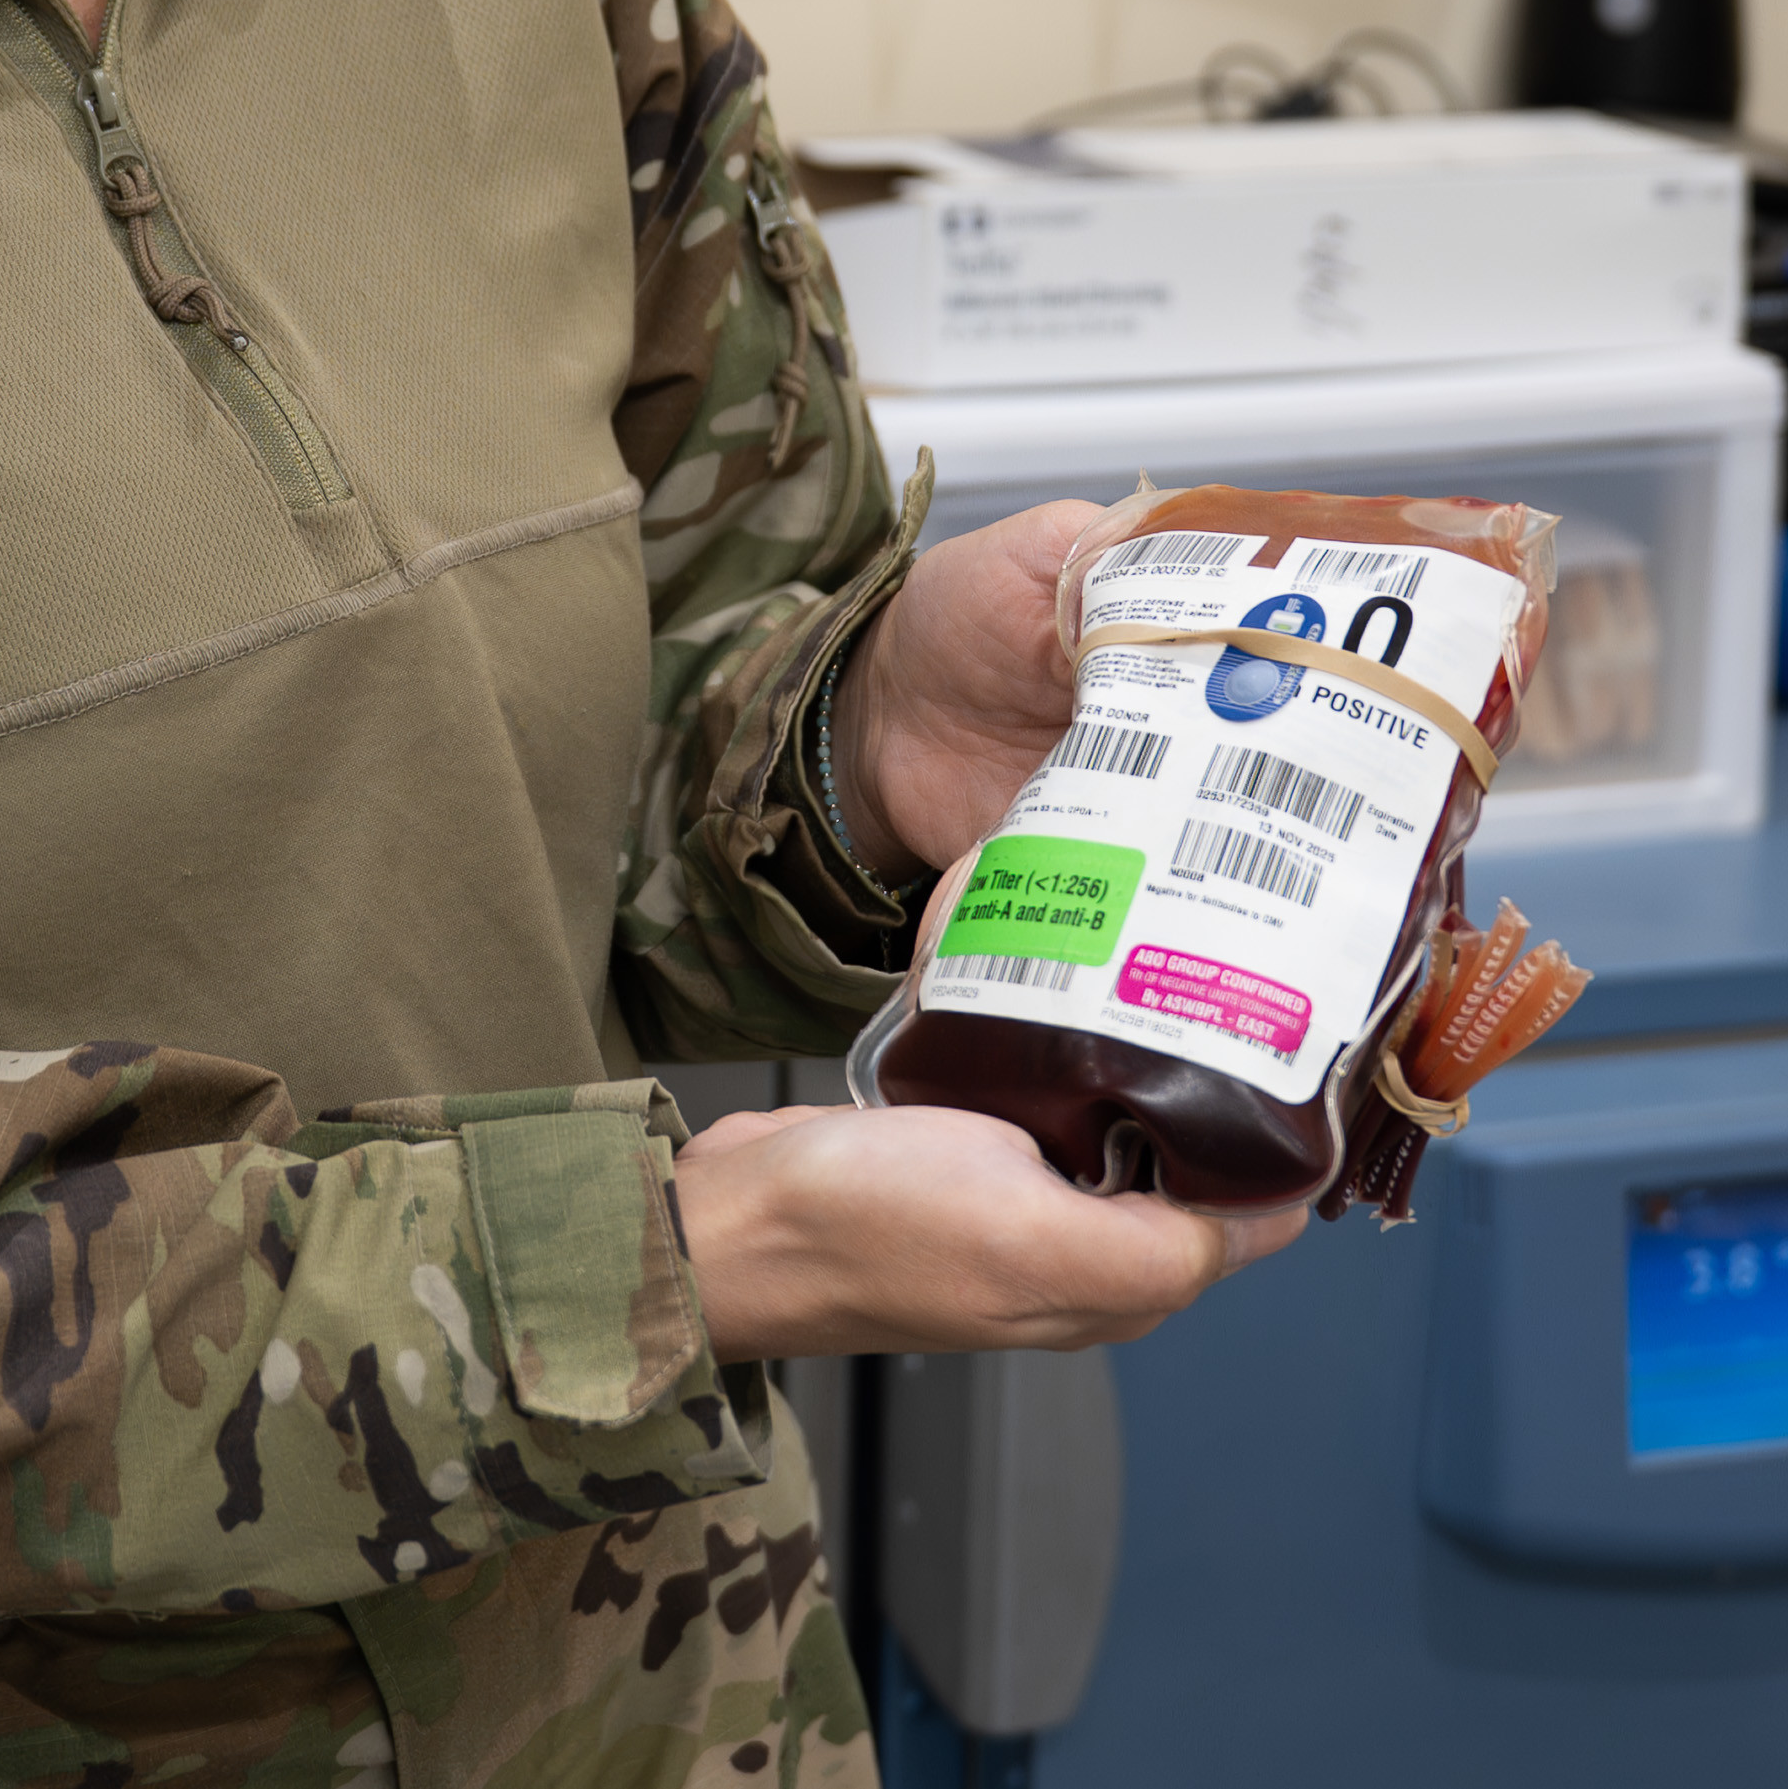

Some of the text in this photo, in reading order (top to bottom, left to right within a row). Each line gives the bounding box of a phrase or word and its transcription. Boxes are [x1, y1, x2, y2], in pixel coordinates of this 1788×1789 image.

[1131, 566, 1150, 576] 25
[1150, 565, 1201, 577] 003159
[1106, 707, 1150, 724] DONOR
[1312, 686, 1429, 750] POSITIVE
[1258, 821, 1273, 834] 13
[1276, 829, 1304, 847] NOV
[1366, 803, 1415, 834] Expiration
[1374, 823, 1399, 842] Date
[989, 869, 1023, 892] Titer
[1025, 870, 1110, 904] (<1:256)
[971, 900, 1013, 921] anti-A
[1015, 903, 1048, 923] and
[1050, 906, 1106, 931] anti-B
[1133, 948, 1307, 1013] ABO GROUP CONFIRMED
[1160, 974, 1207, 997] NEGATIVE
[1207, 988, 1239, 1006] UNITS
[1141, 988, 1162, 1009] By
[1161, 993, 1224, 1023] ASWBPL
[1235, 1014, 1277, 1041] EAST
